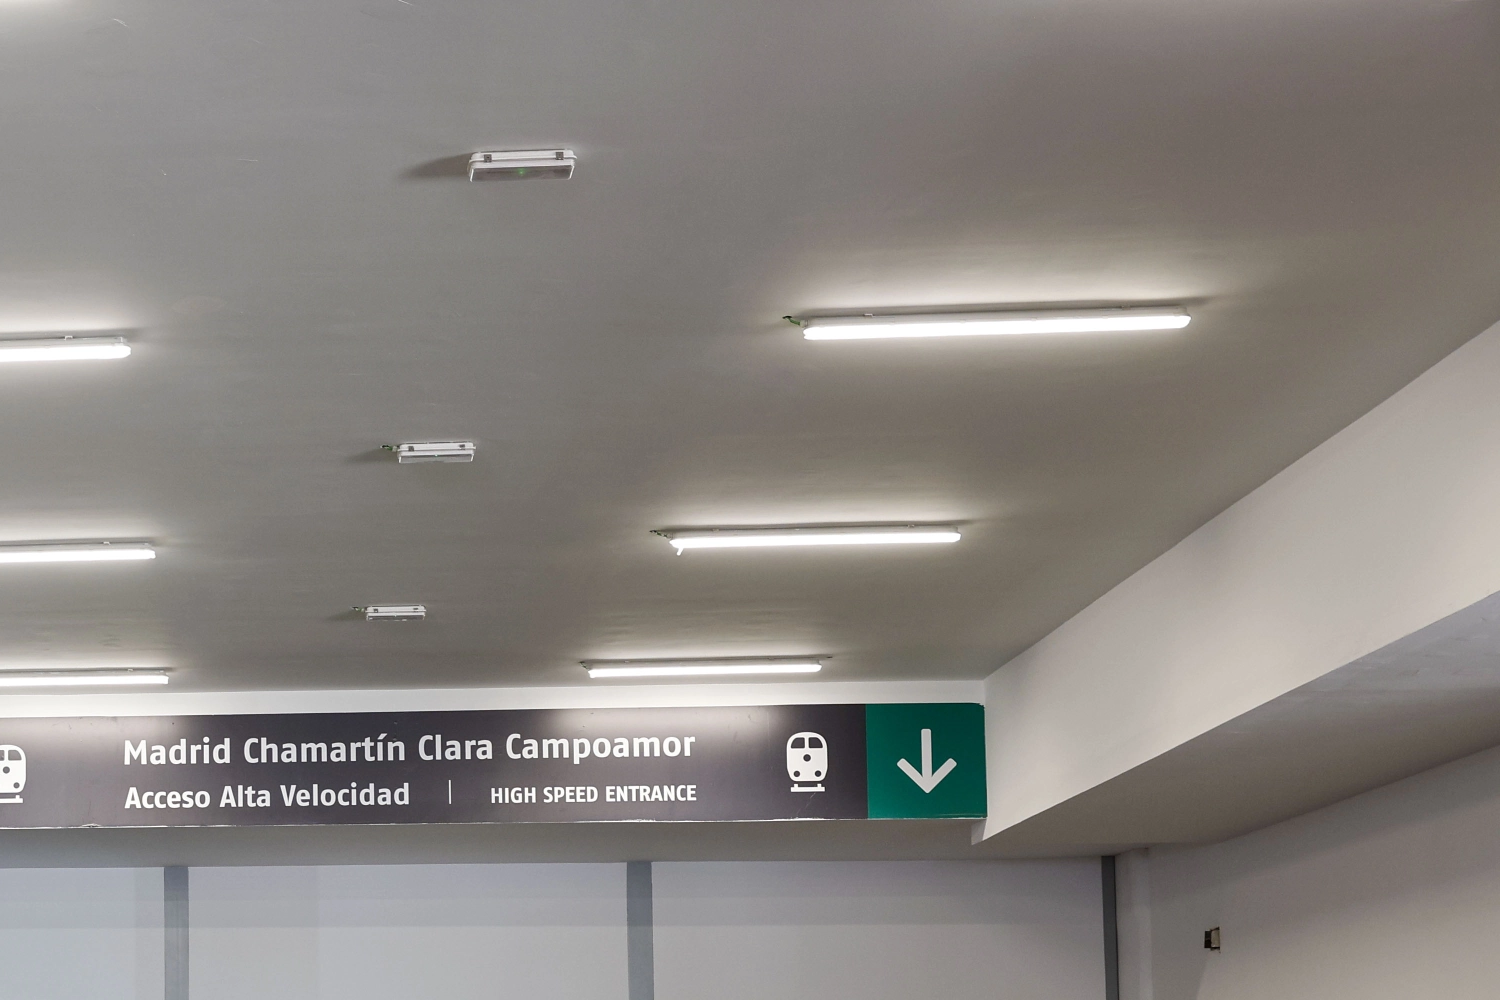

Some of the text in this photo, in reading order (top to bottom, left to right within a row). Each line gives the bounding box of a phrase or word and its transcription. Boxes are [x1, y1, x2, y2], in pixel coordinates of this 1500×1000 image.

[123, 733, 696, 766] Madrid Chamartín Clara Campoamor
[124, 781, 409, 810] Acceso Alta Velocidad
[490, 784, 697, 804] HIGH SPEED ENTRANCE
